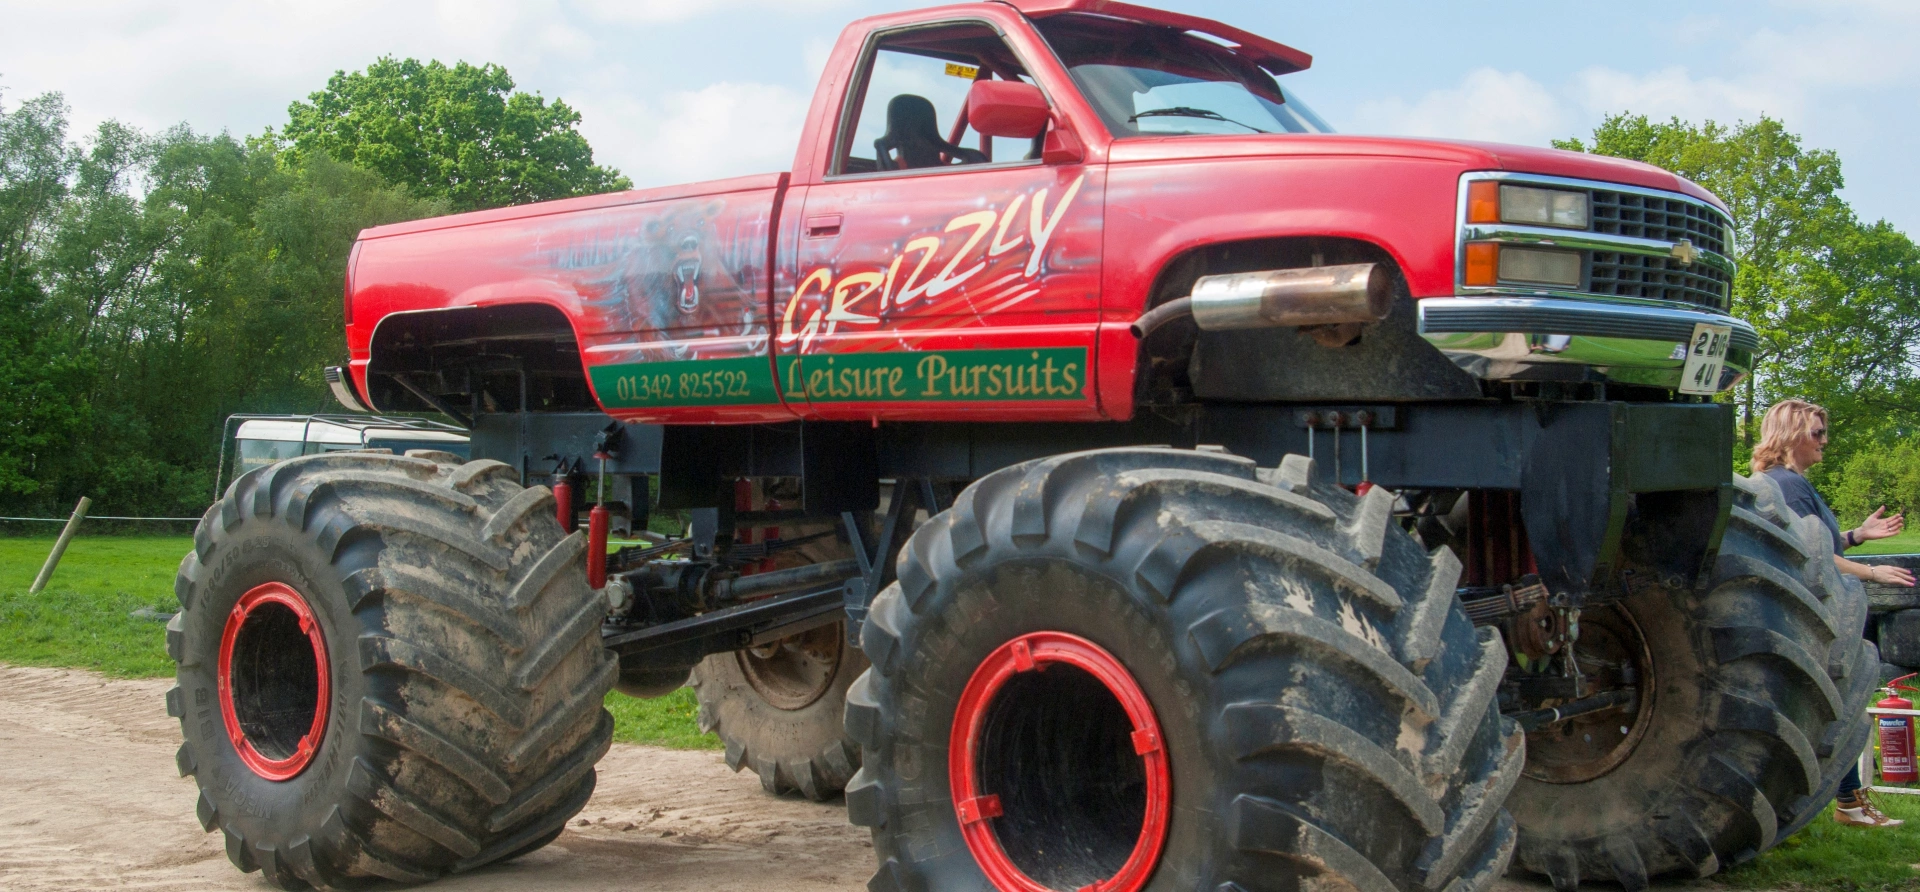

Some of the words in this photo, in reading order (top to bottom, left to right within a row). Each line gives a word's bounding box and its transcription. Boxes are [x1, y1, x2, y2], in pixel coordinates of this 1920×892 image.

[779, 175, 1084, 354] GRIZZLY
[1694, 332, 1708, 355] 2
[1707, 333, 1728, 357] BIG
[617, 374, 674, 401] 01342
[679, 370, 751, 398] 825522
[785, 357, 906, 398] Leisure
[917, 351, 1078, 397] Pursuits
[195, 687, 215, 742] BIB
[1879, 719, 1906, 727] Powder
[305, 694, 347, 805] MICHELIN
[225, 773, 273, 820] MEGA
